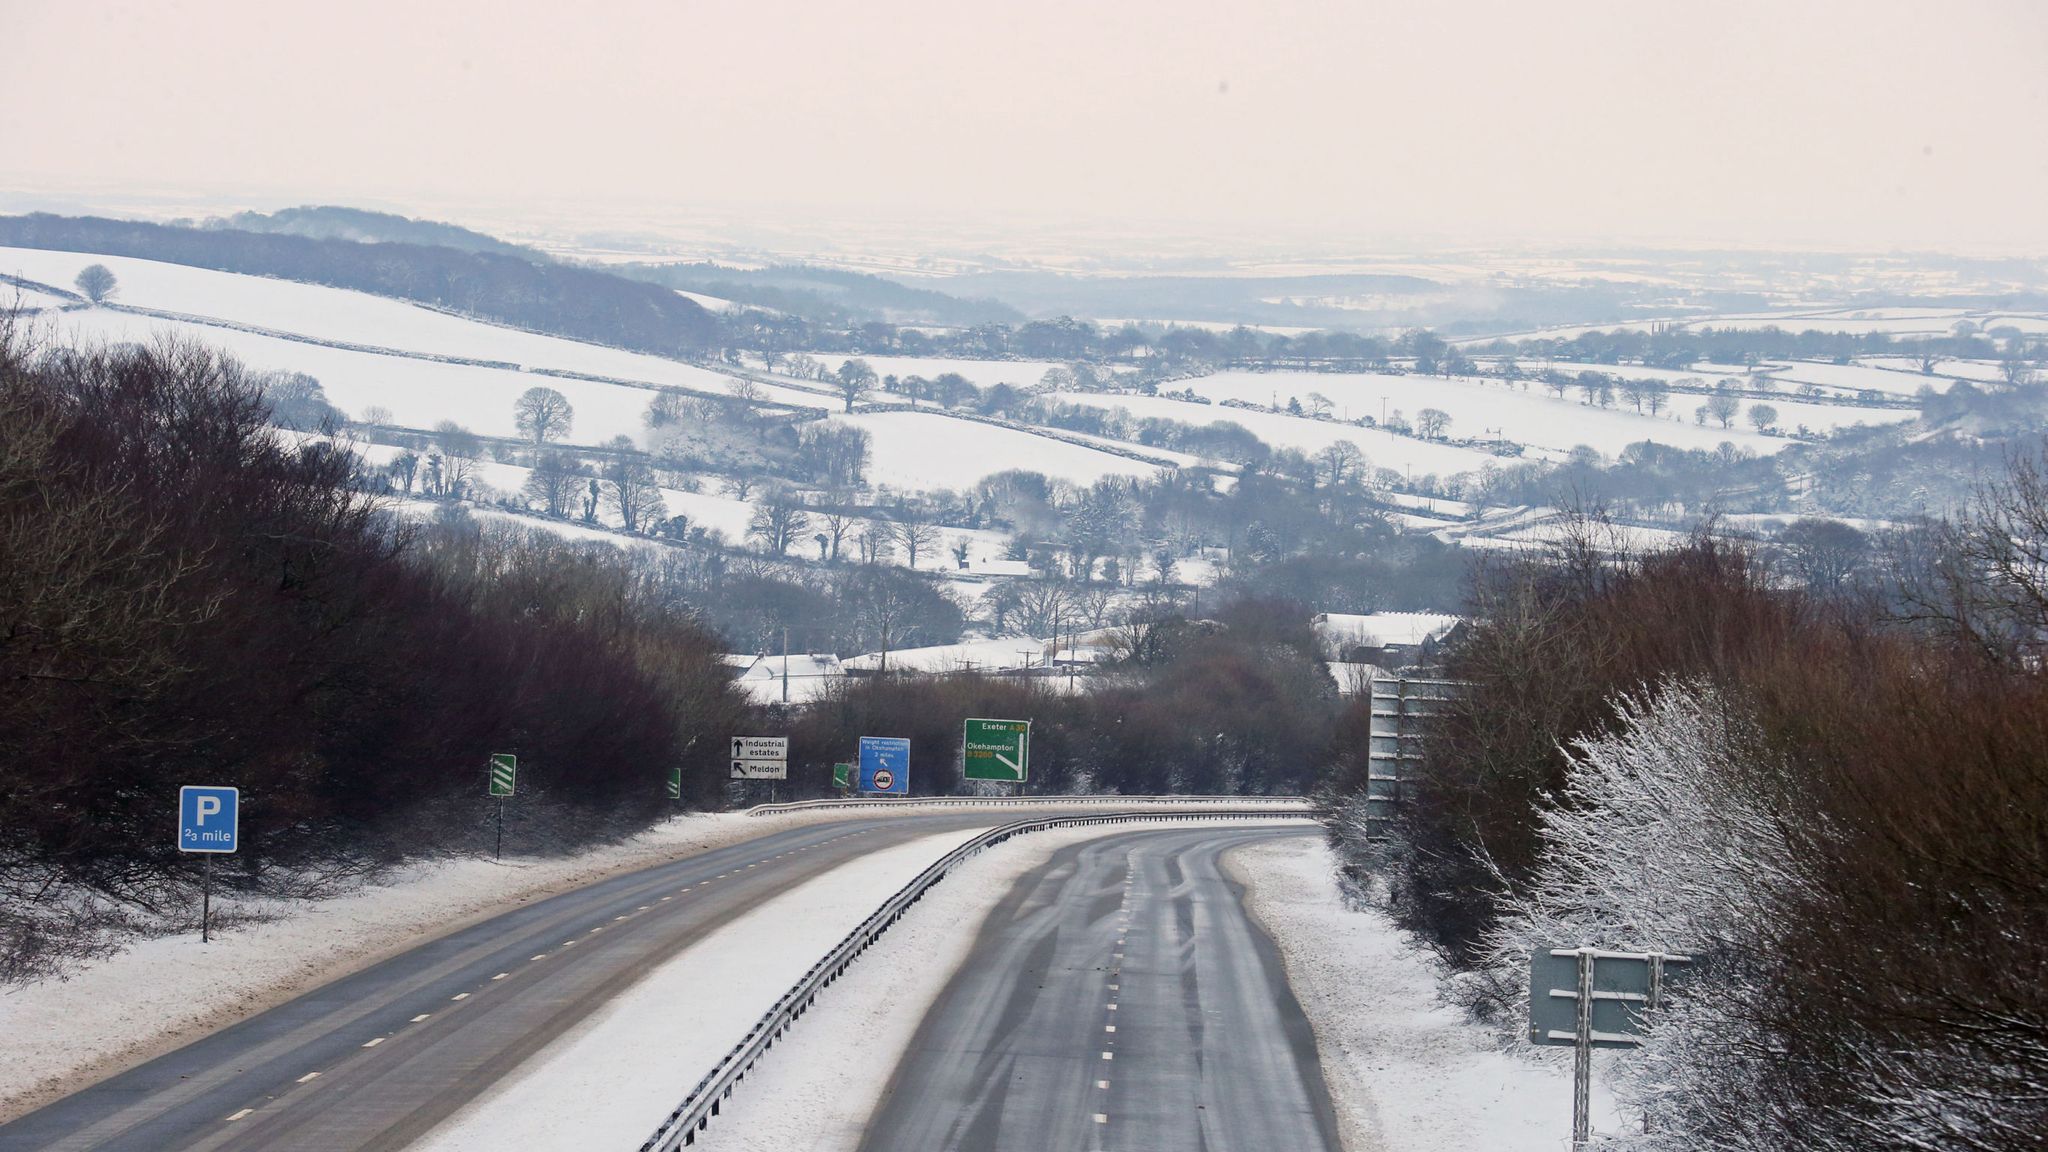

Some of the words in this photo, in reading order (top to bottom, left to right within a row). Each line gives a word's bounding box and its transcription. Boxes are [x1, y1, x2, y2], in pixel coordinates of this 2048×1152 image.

[982, 722, 1007, 731] Exeter
[745, 740, 785, 748] Industrial
[967, 742, 1015, 752] Okehampton
[749, 749, 780, 757] estates
[749, 765, 780, 773] Meldon
[196, 795, 222, 827] P
[202, 829, 232, 842] mile
